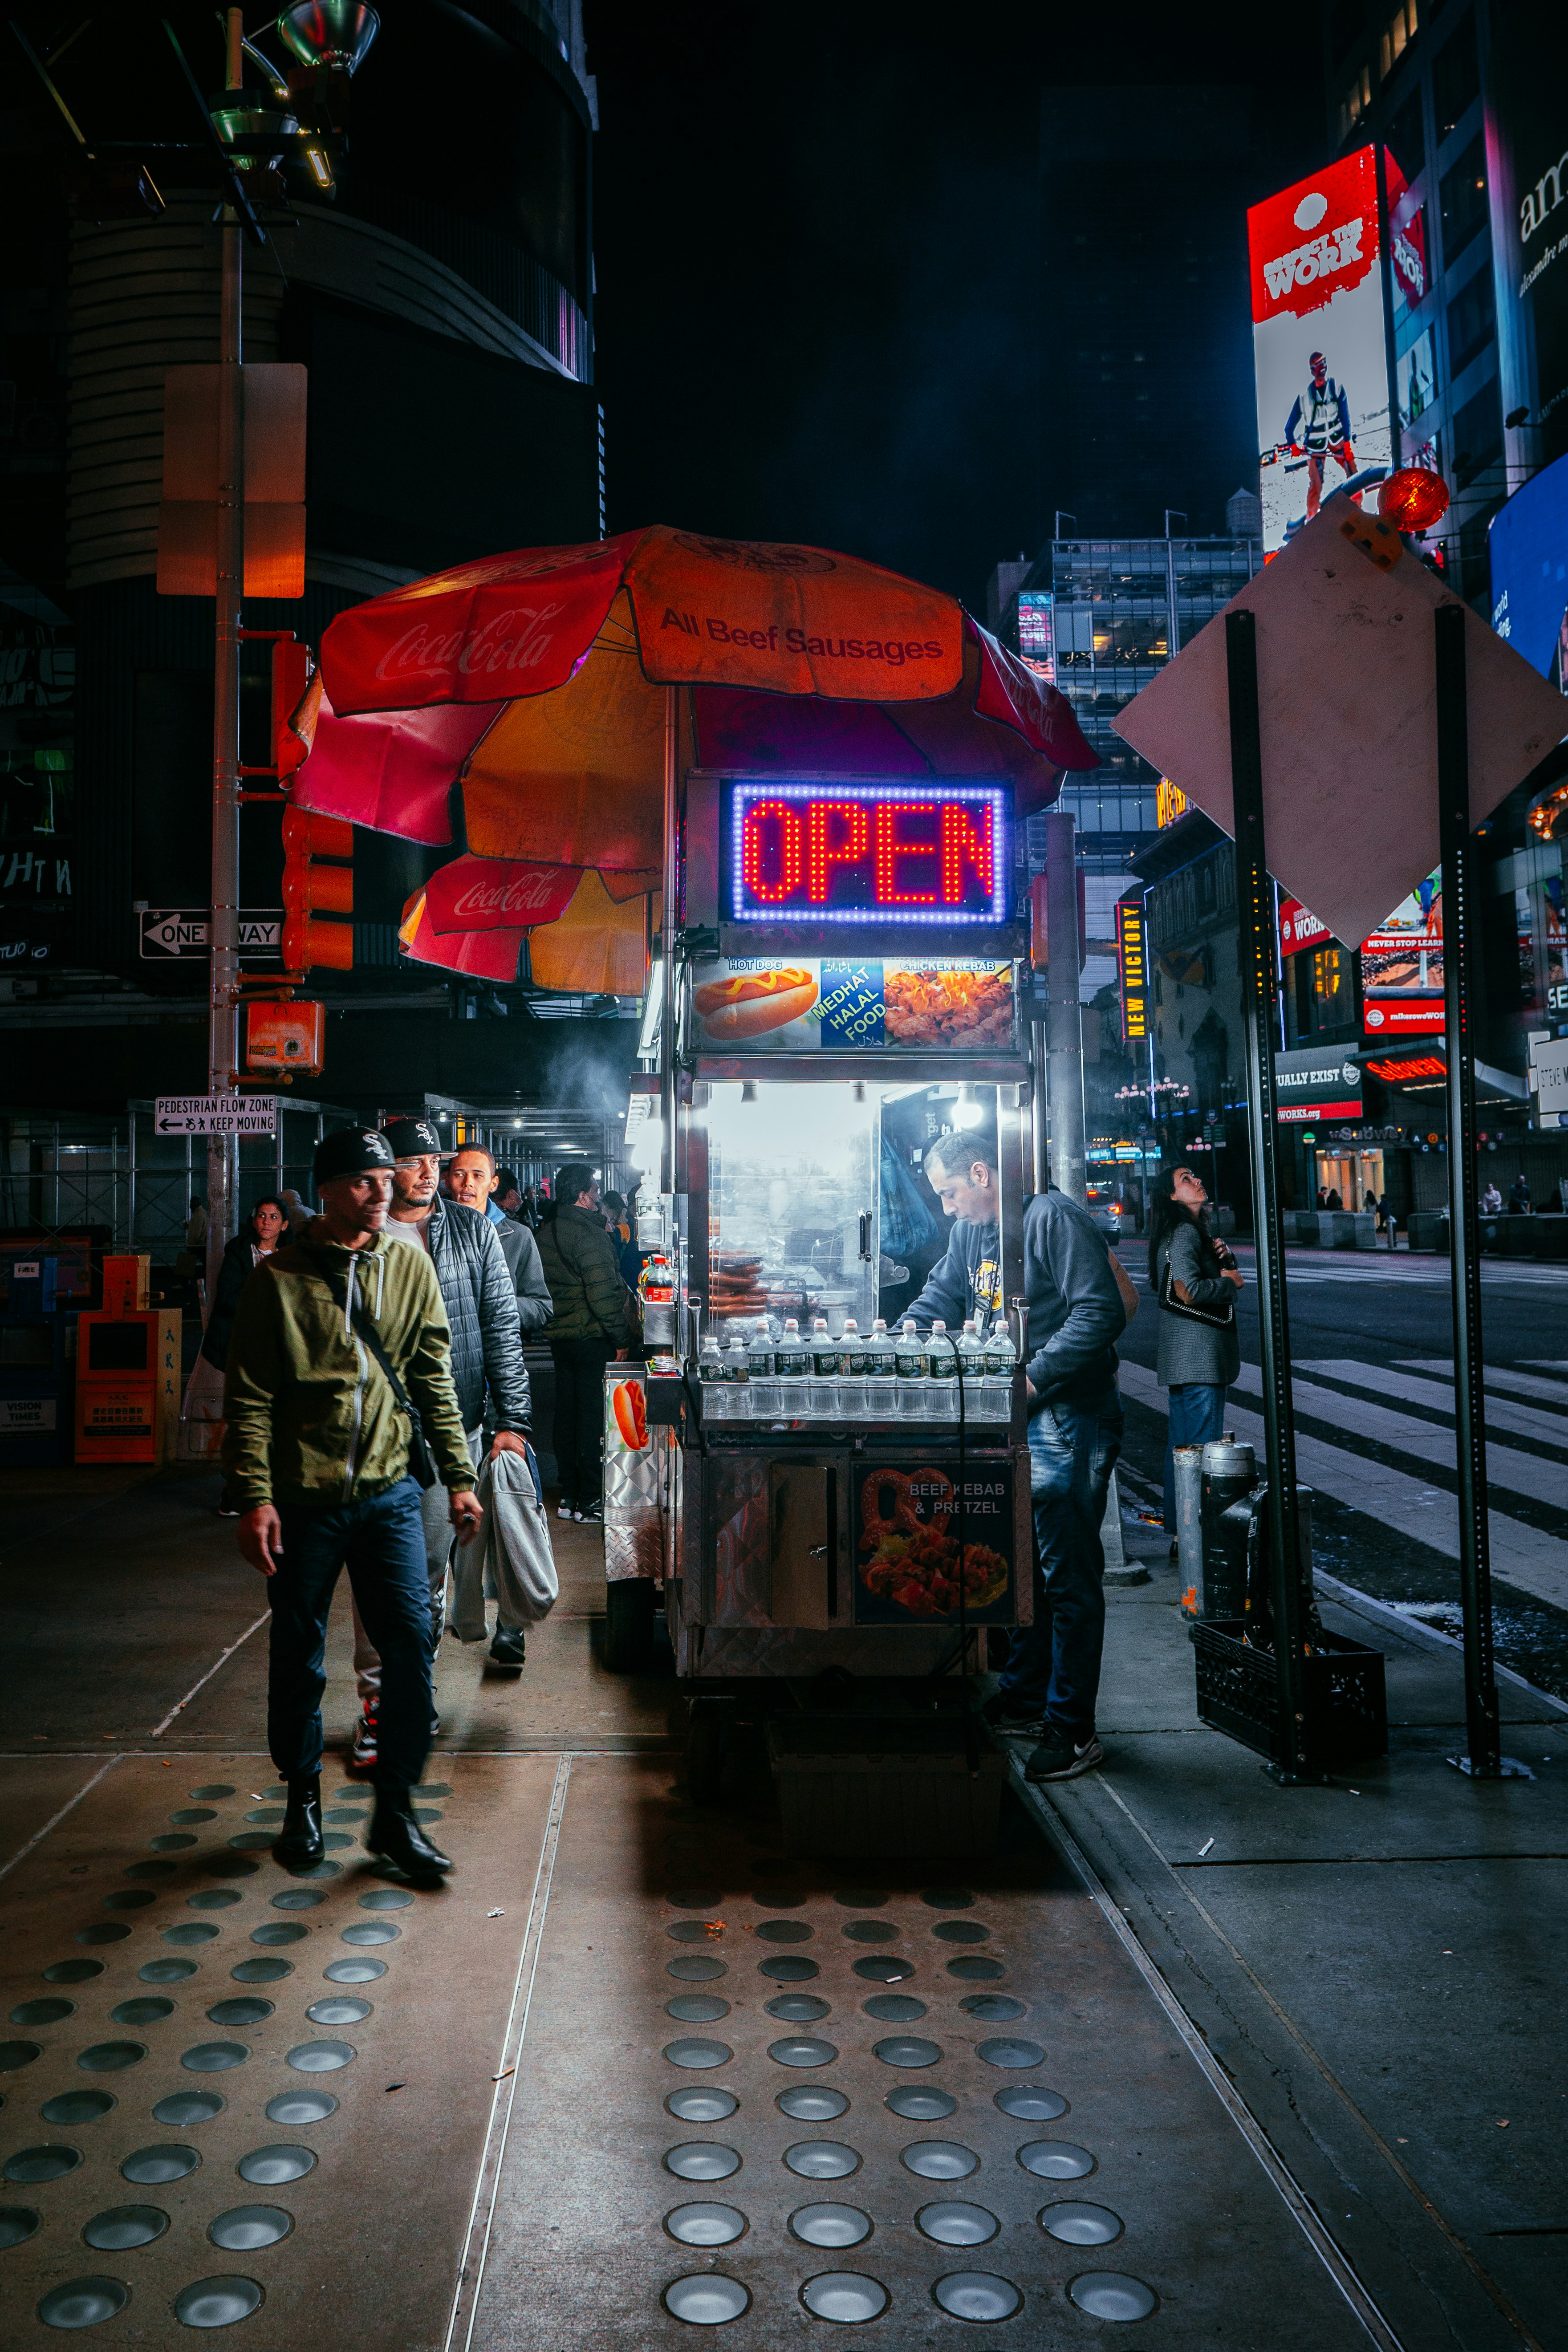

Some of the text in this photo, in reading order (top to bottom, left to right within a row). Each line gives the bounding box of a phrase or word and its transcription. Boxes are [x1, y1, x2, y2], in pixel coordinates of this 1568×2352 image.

[1266, 232, 1363, 299] WORK
[660, 608, 943, 666] All Beef Sausages
[743, 803, 994, 903] OPEN
[162, 925, 204, 943] ONE
[1368, 940, 1395, 948] NEVER
[729, 959, 783, 970] HOT DOG
[900, 960, 995, 971] CHICKEN KEBAB
[1123, 908, 1145, 1036] NEW VICTORY
[812, 966, 870, 1020] MEDHAT
[829, 989, 879, 1030] HALAL
[845, 1003, 886, 1041] FOOD
[858, 1035, 883, 1047] حلال
[1310, 1068, 1340, 1084] EXIST
[1366, 1056, 1447, 1082] Subway
[158, 1099, 274, 1113] PEDESTRIAN FLOW ZONE
[210, 1117, 273, 1130] KEEP MOVING
[7, 1402, 41, 1411] VISION
[9, 1412, 40, 1421] TIMES
[910, 1483, 1005, 1496] BEEF KEBAB
[914, 1502, 1001, 1514] & PRETZEL
